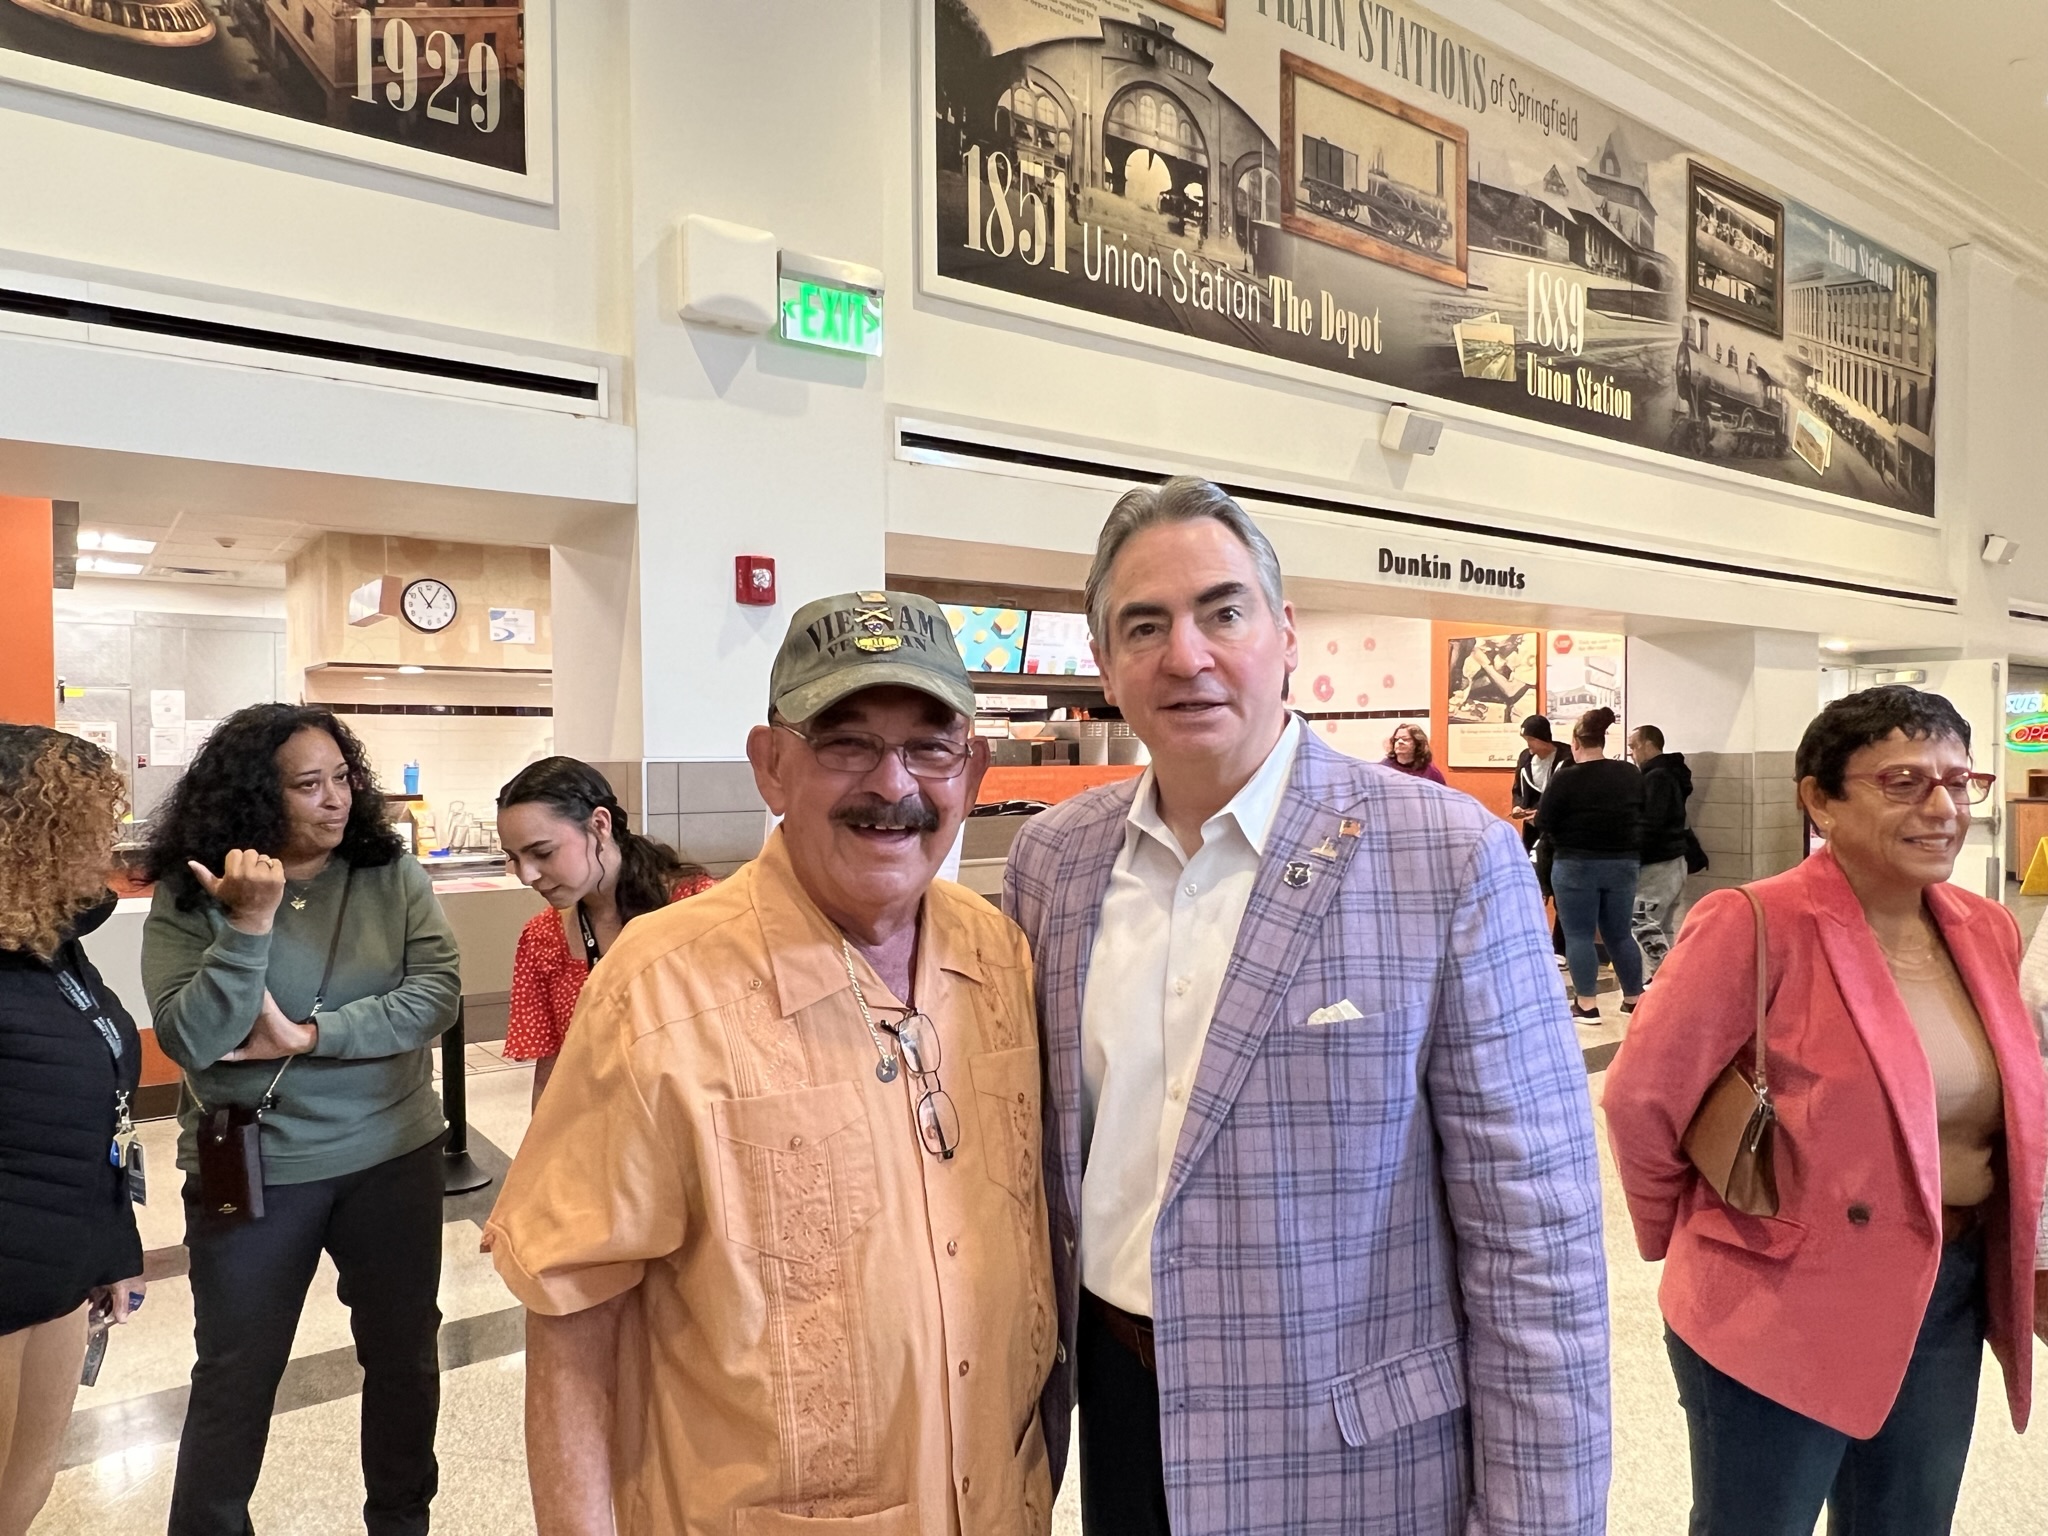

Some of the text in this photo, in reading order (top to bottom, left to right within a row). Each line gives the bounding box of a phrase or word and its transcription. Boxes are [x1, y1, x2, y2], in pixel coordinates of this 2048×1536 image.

[350, 8, 501, 133] 1929
[1256, 0, 1579, 142] AIN STATIONS of Springfield
[963, 144, 1383, 360] 1851 Union Station The Depot
[1828, 228, 1857, 274] Union
[1859, 243, 1894, 292] Station
[801, 283, 867, 347] EXIT
[1525, 266, 1585, 357] 1889
[1526, 351, 1632, 421] Union Station
[1378, 547, 1526, 590] Dunkin Donuts
[827, 634, 928, 659] VEAN
